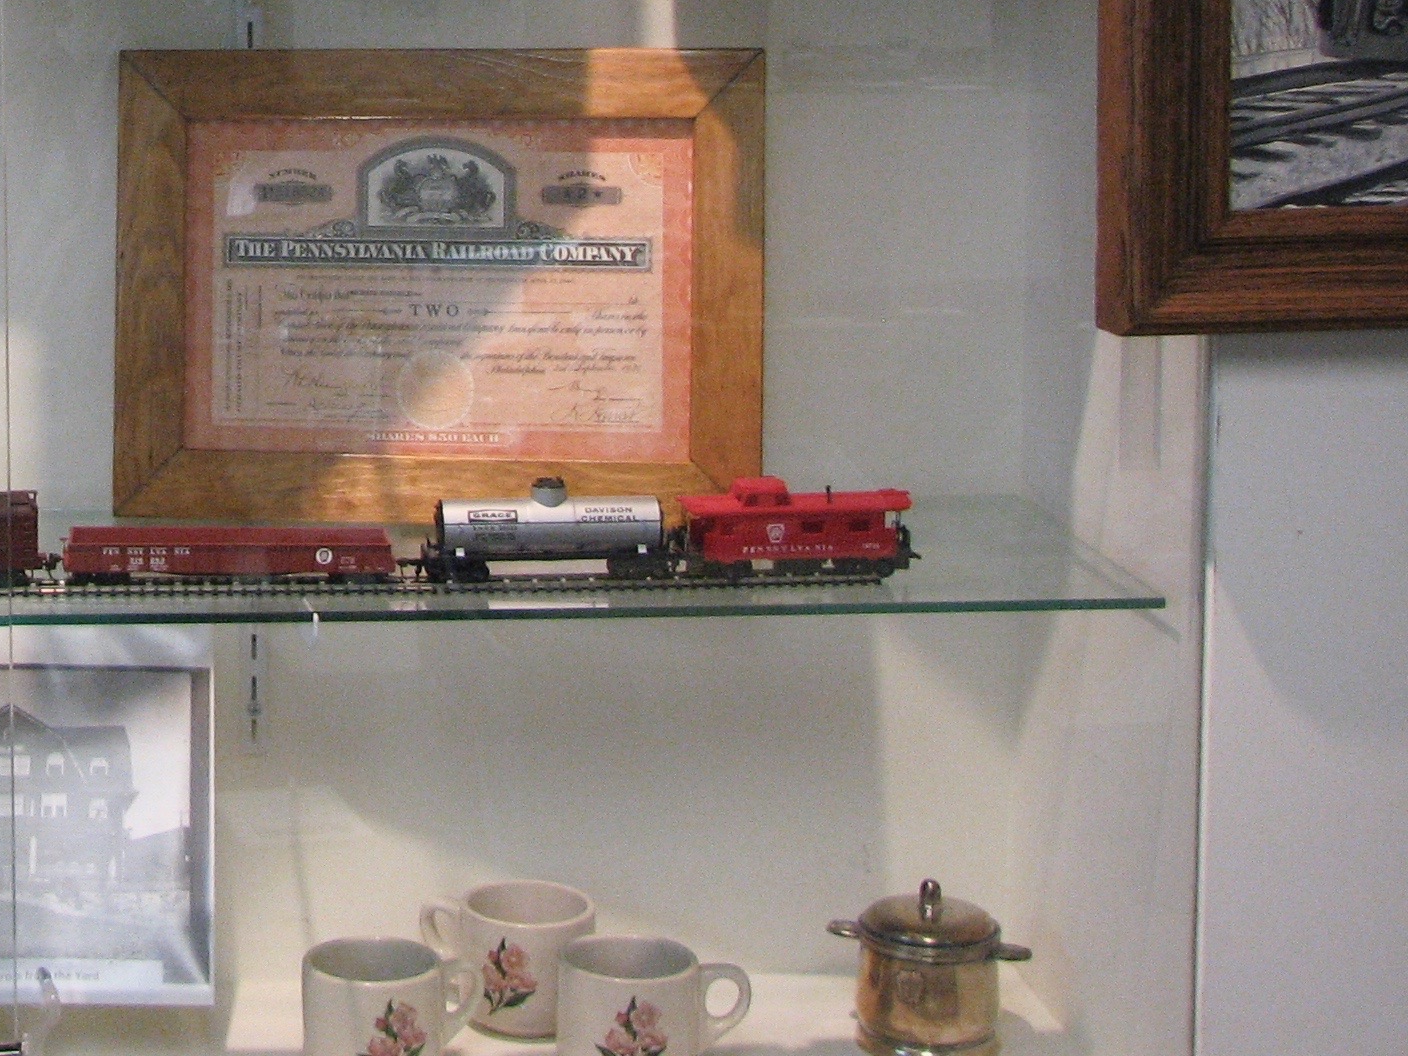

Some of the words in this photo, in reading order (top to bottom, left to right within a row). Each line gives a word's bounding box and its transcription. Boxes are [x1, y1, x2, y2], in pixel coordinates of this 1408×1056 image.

[234, 240, 275, 258] THE
[280, 241, 428, 260] PENNSYLVANIA
[432, 242, 535, 261] RAILROAD
[540, 243, 639, 262] COMPANY
[409, 304, 459, 317] TWO
[461, 433, 499, 443] EACH
[581, 515, 638, 523] CHEMICAL
